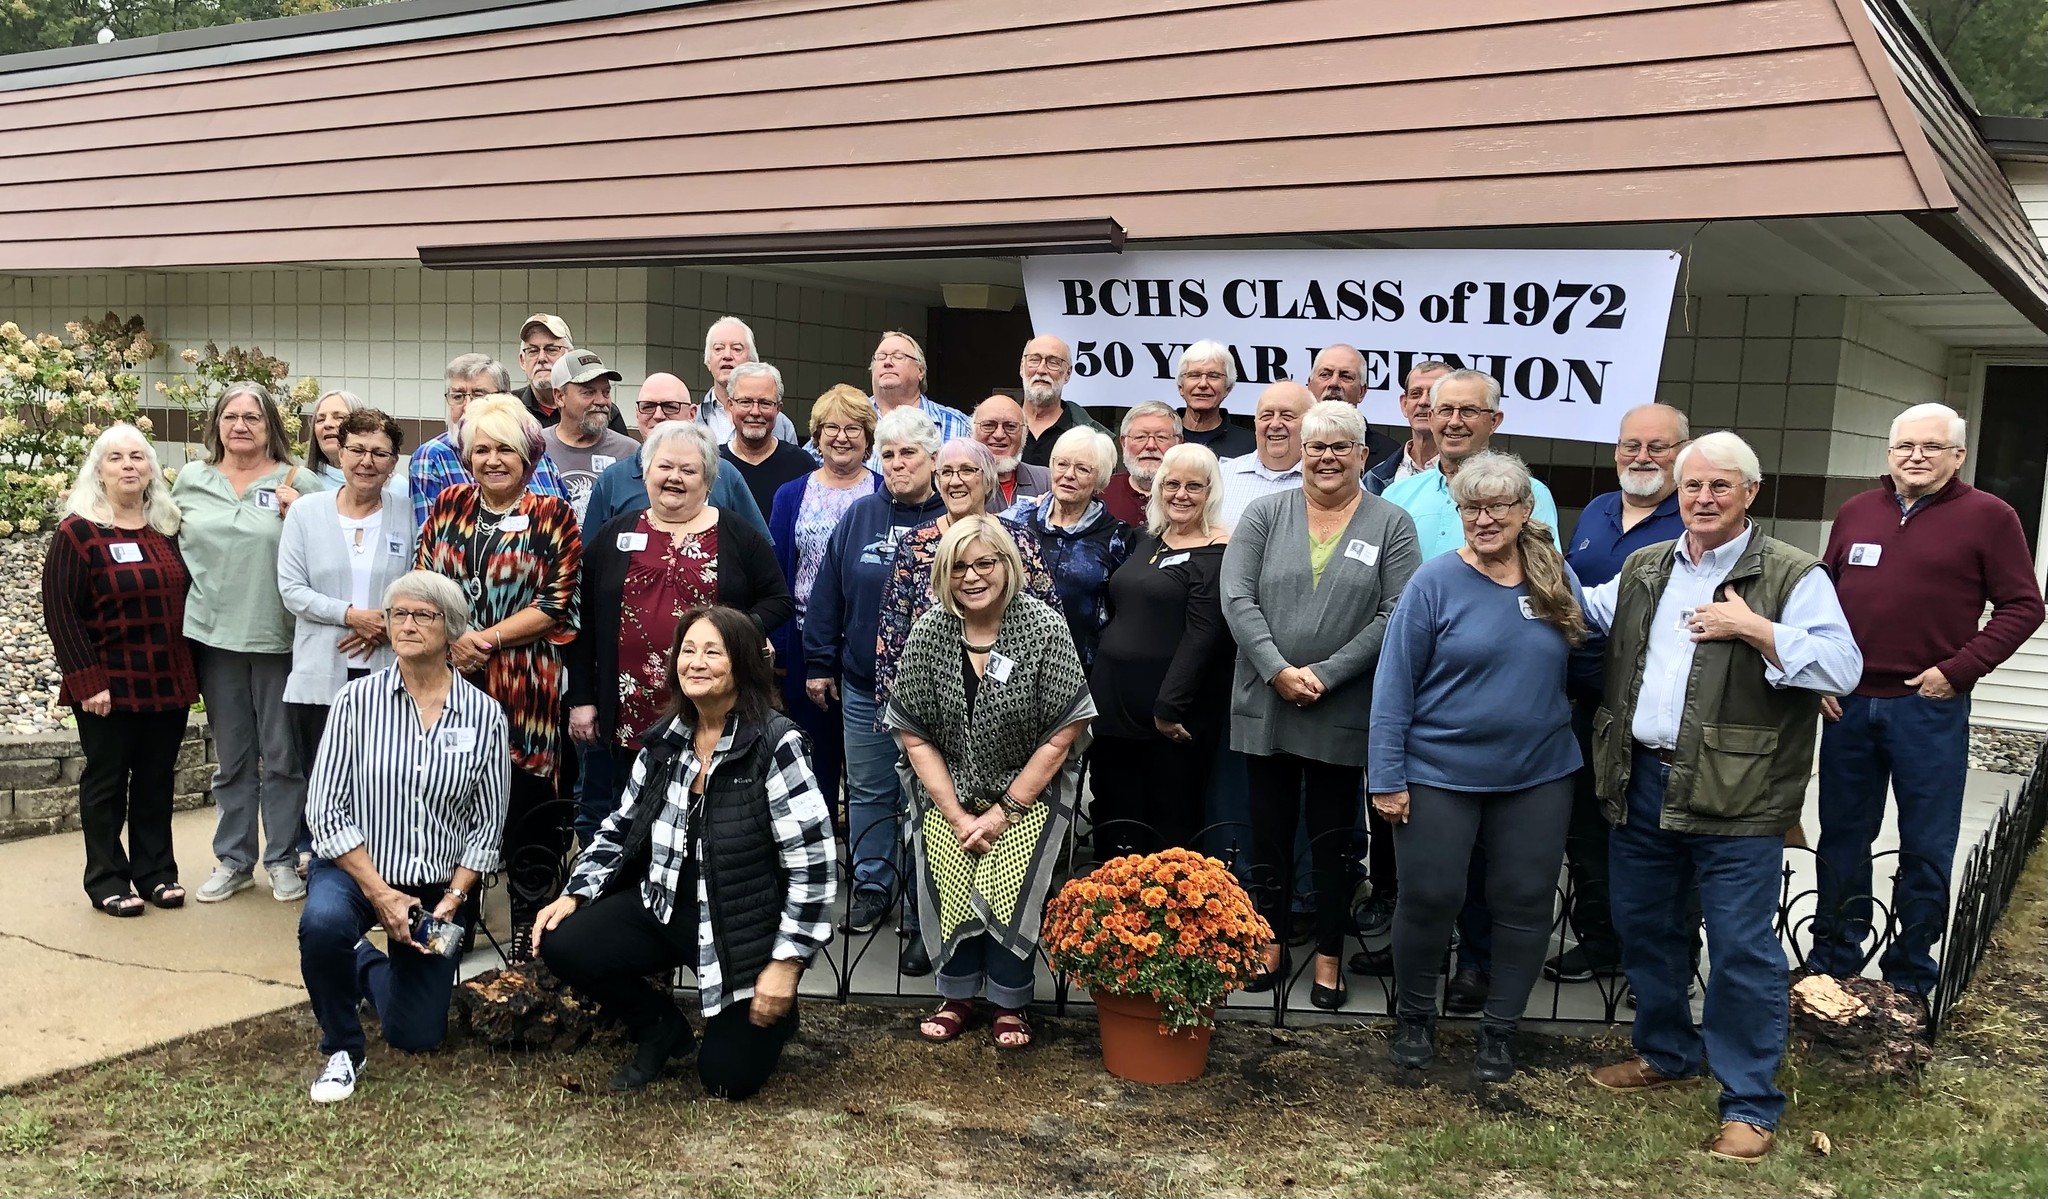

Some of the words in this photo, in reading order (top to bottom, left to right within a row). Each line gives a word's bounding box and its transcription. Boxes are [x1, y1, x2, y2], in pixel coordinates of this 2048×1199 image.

[1058, 278, 1209, 318] BCHS
[1222, 278, 1405, 322] CLASS
[1419, 281, 1479, 324] of
[1482, 279, 1627, 335] 1972
[1074, 340, 1134, 378] 50
[1141, 342, 1294, 384] YAR
[1305, 346, 1613, 405] EUION
